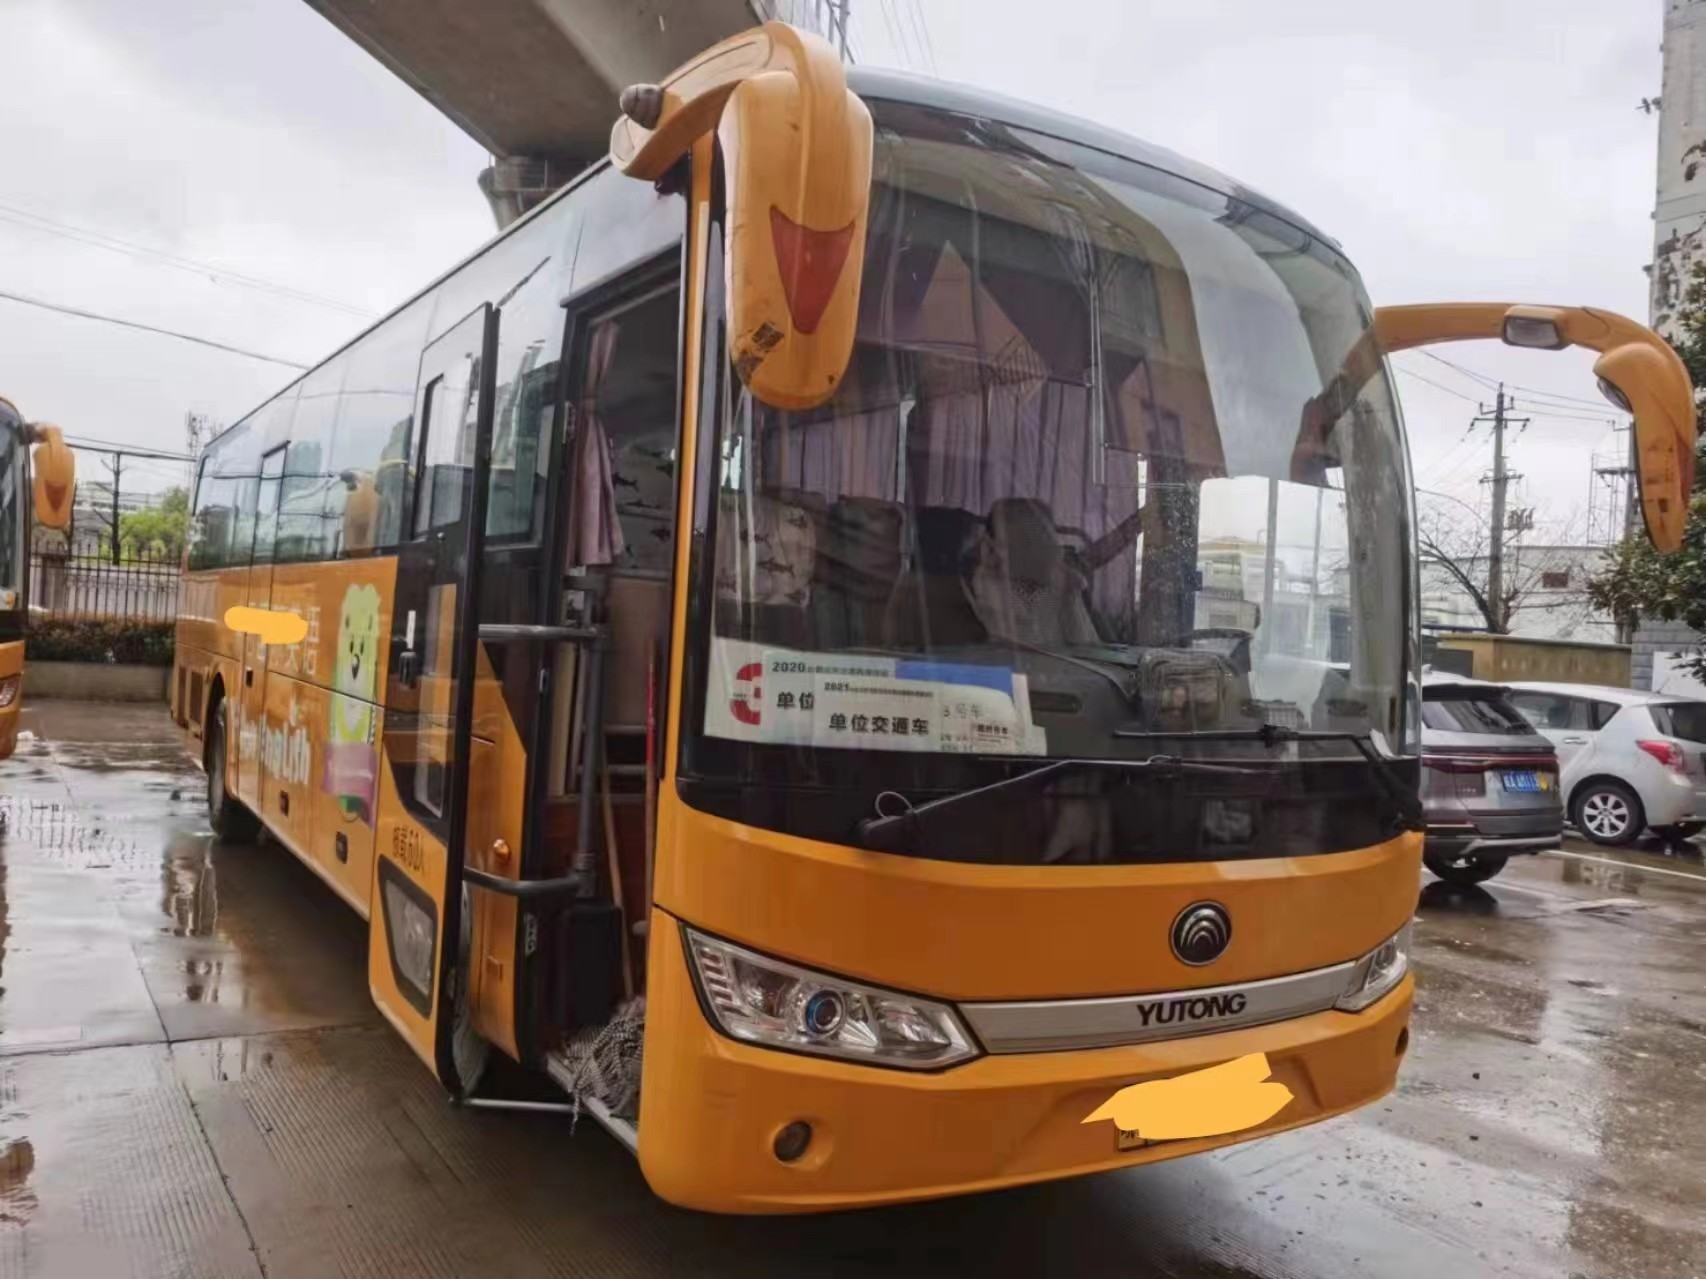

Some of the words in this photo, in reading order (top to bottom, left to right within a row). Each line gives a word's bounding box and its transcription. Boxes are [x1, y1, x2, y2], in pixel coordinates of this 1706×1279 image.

[772, 661, 806, 673] 2020
[829, 712, 929, 736] 单位交通车
[1137, 993, 1247, 1027] YUTONG
